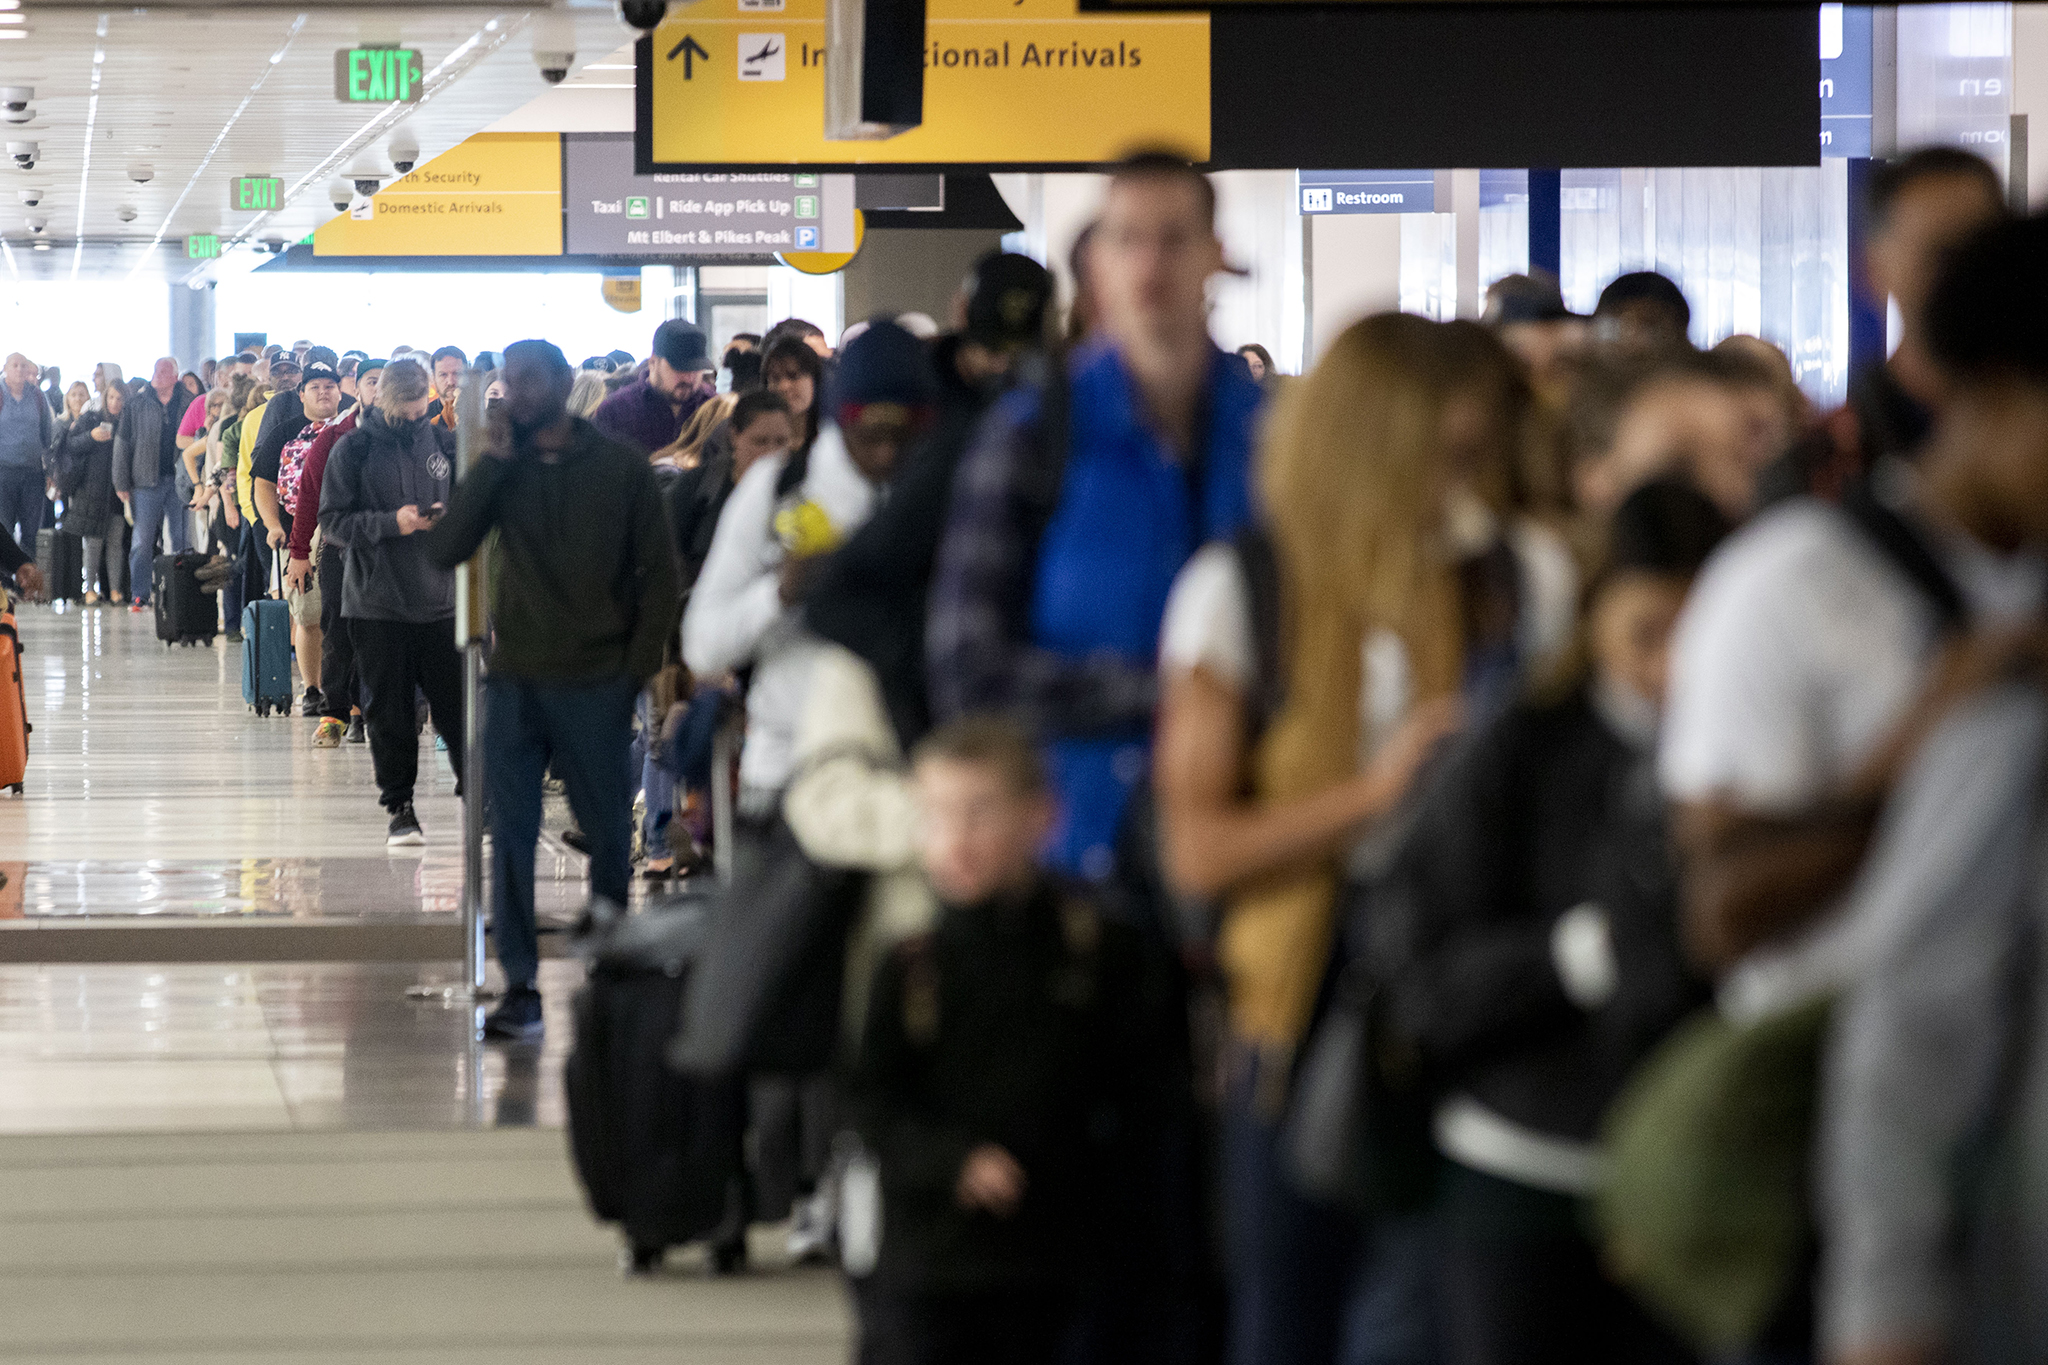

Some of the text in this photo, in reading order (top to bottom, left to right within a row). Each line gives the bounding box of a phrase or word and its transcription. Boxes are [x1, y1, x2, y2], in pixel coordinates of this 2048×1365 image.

[802, 41, 1141, 67] Inional Arrivals
[349, 50, 413, 100] EXIT
[424, 171, 480, 186] Security
[240, 178, 278, 208] EXIT
[1336, 191, 1404, 205] Restroom
[379, 201, 502, 214] Domestic Arrivals
[592, 200, 622, 214] Taxi
[669, 199, 791, 217] Ride App Pick Up
[628, 230, 791, 244] Mt Elbert & Pikes Peak
[188, 235, 218, 258] EXIT
